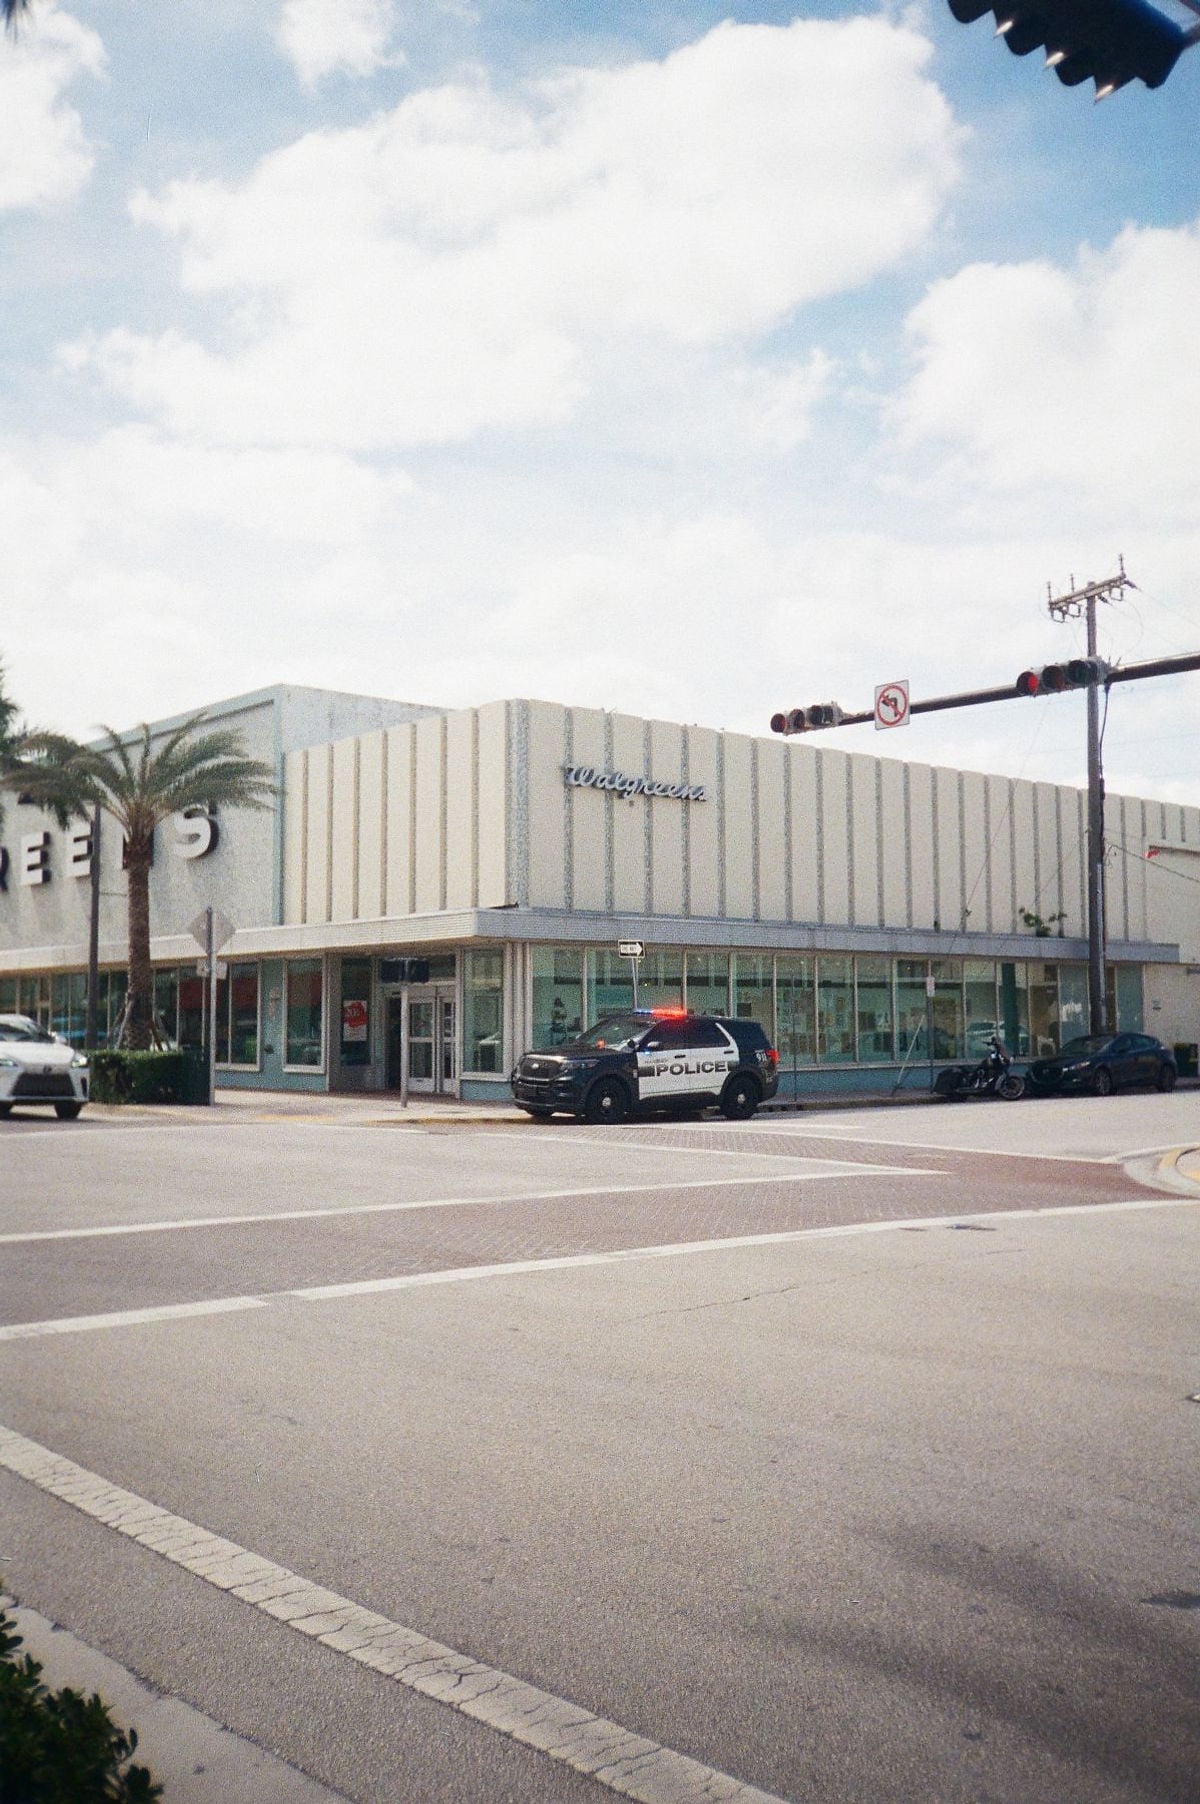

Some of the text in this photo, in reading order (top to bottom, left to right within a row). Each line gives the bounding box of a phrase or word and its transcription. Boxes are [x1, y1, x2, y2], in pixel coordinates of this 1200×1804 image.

[566, 766, 706, 800] Walgreens
[0, 801, 219, 891] EES
[656, 1061, 727, 1077] POLICE
